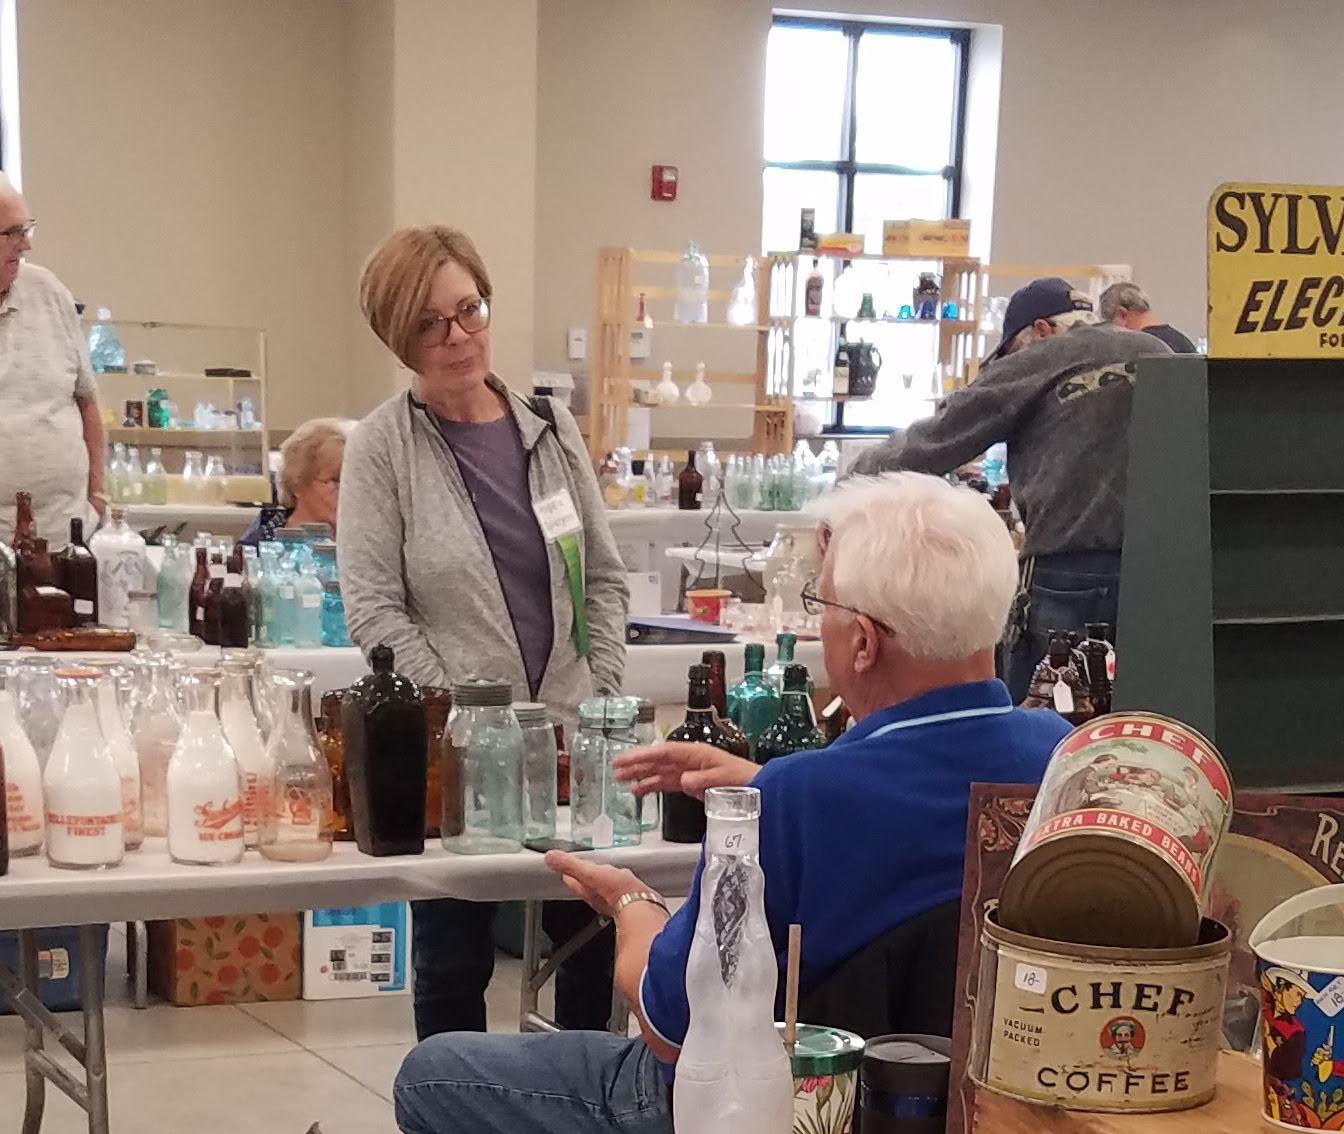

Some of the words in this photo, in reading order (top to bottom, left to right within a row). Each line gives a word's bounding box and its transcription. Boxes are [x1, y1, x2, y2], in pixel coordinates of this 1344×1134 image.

[1089, 723, 1213, 765] CHEF
[1096, 812, 1153, 837] BAKED
[1161, 833, 1198, 882] BEANS
[1051, 981, 1196, 1017] CHEF
[1003, 1017, 1043, 1035] VACUUM
[1003, 1030, 1041, 1047] PACKED
[1037, 1066, 1191, 1095] COFFEE
